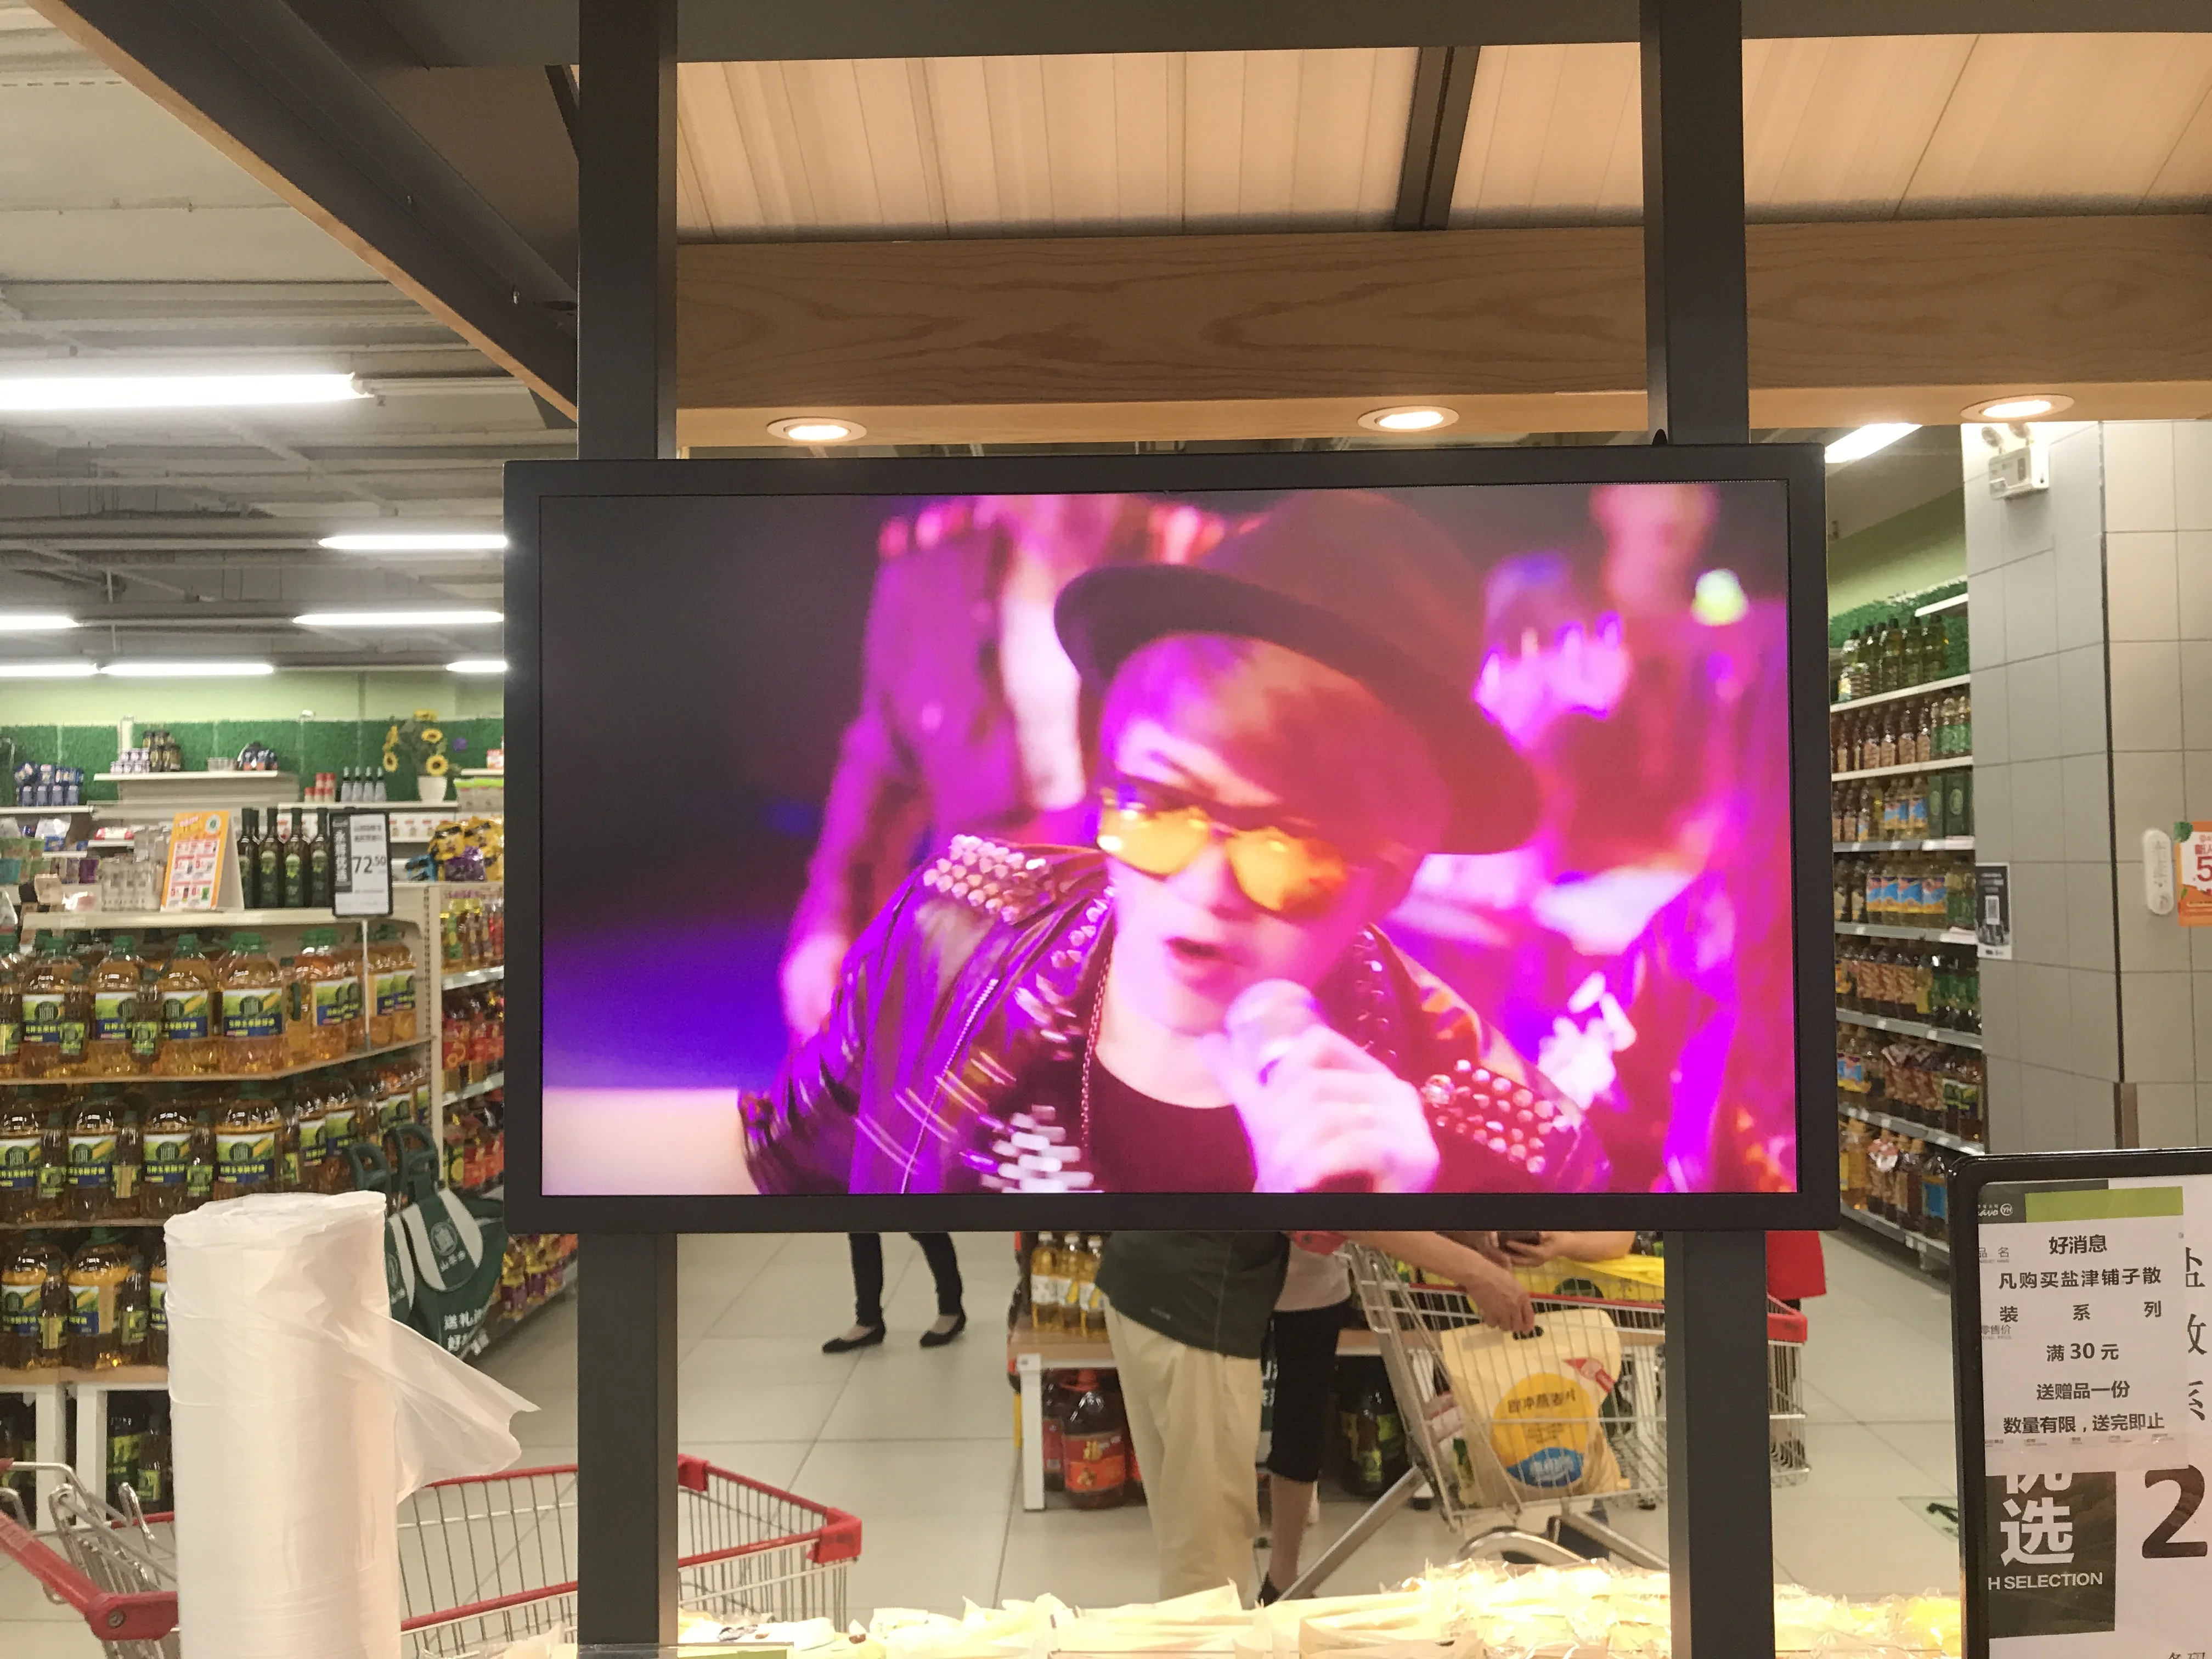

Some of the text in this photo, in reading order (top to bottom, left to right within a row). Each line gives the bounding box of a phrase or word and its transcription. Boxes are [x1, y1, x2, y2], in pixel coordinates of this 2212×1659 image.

[2049, 1234, 2108, 1255] 好消息
[1999, 1266, 2161, 1290] 凡购买盐津铺子散
[2036, 1381, 2130, 1400] 送赠品一份
[2004, 1572, 2103, 1589] SELECTION
